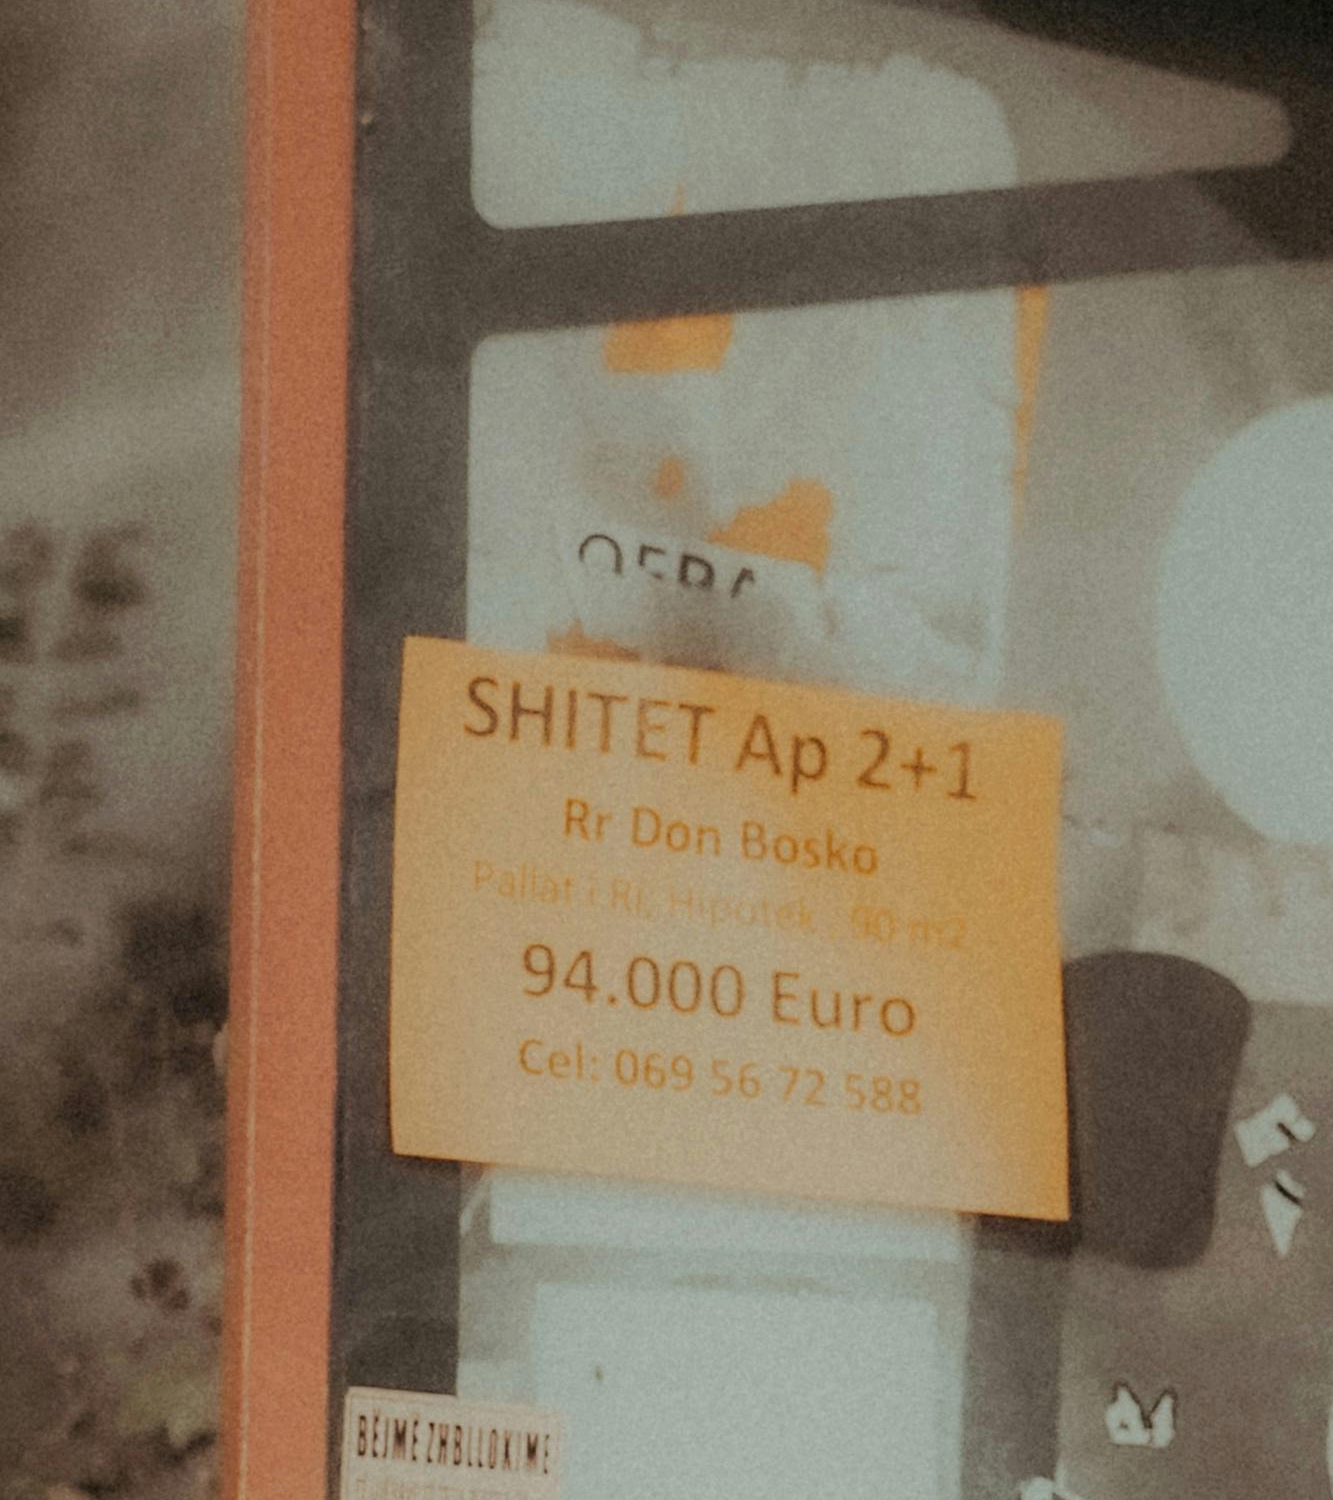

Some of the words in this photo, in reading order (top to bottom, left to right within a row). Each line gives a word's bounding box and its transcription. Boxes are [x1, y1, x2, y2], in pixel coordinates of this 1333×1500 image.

[464, 676, 714, 765] SHITET
[735, 713, 829, 795] Ap
[857, 729, 977, 801] 2+1
[563, 797, 612, 840] Rr
[630, 806, 722, 855] Don
[740, 819, 880, 876] Bosko
[523, 943, 744, 1017] 94.000
[772, 971, 917, 1037] Euro
[518, 1038, 599, 1081] Cel:
[615, 1048, 694, 1092] 069
[710, 1059, 762, 1099] 56
[778, 1065, 826, 1108] 72
[844, 1073, 922, 1116] 588
